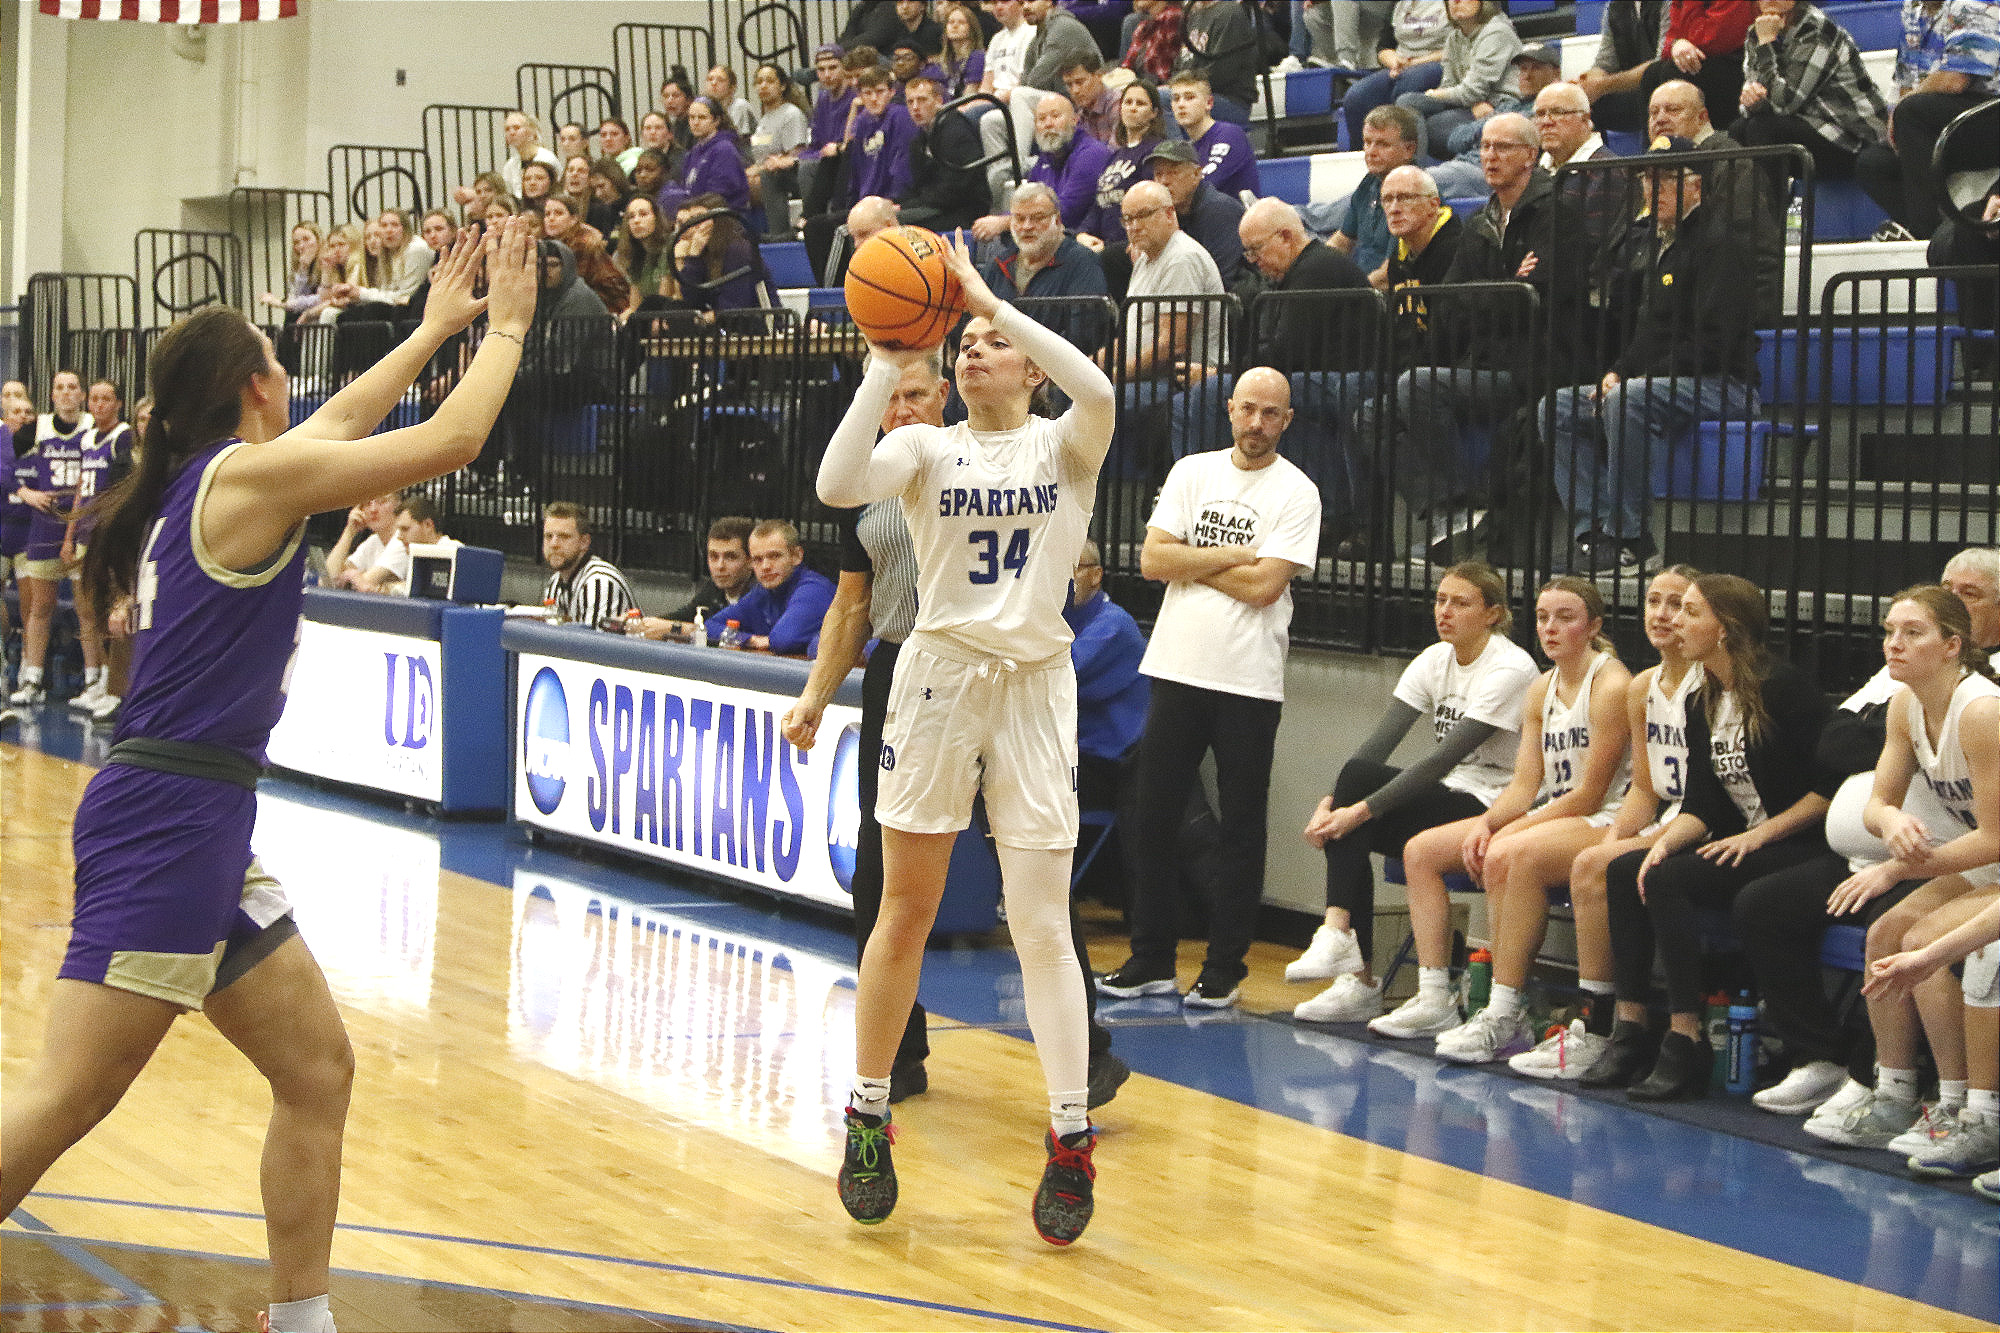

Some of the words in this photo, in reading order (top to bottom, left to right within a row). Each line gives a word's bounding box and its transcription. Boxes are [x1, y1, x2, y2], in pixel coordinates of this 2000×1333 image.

[939, 482, 1058, 518] SPARTANS
[1195, 522, 1256, 545] HISTORY
[1201, 509, 1256, 532] #BLACK
[968, 528, 1030, 585] 34
[587, 678, 809, 883] SPARTANS
